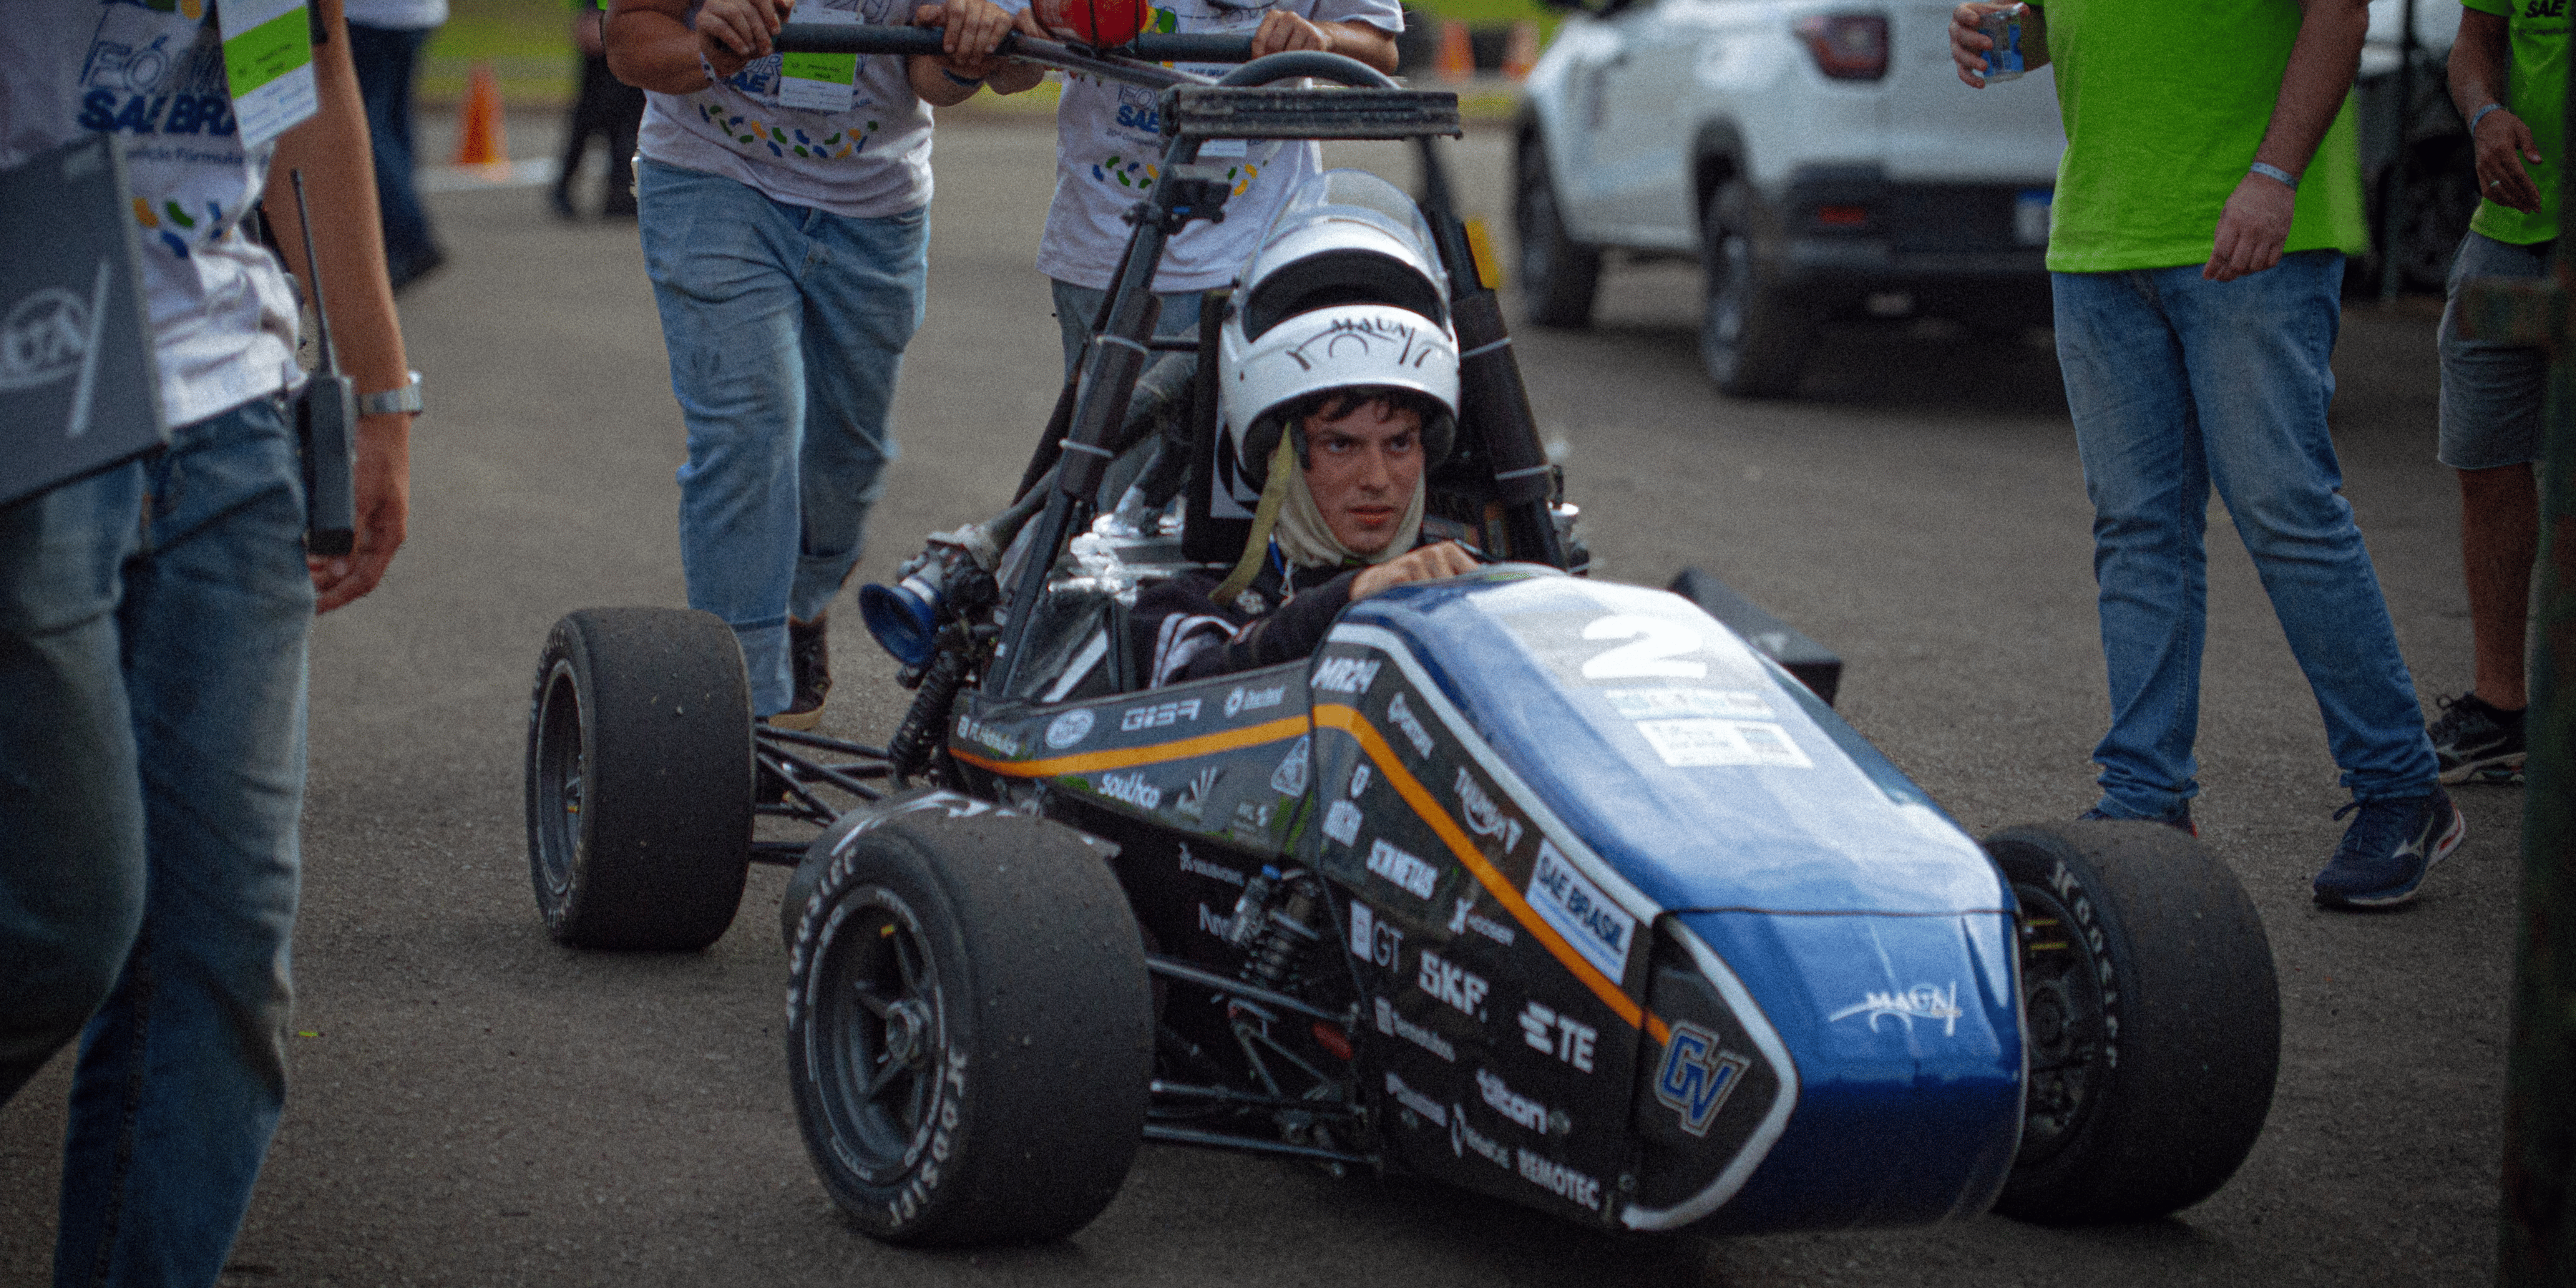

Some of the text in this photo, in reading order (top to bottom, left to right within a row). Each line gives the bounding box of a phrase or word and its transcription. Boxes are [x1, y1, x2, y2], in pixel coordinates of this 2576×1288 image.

[729, 72, 771, 93] AE
[1581, 614, 1707, 680] 2
[1097, 771, 1161, 810] southco
[1538, 855, 1624, 956] SAE BRASIL
